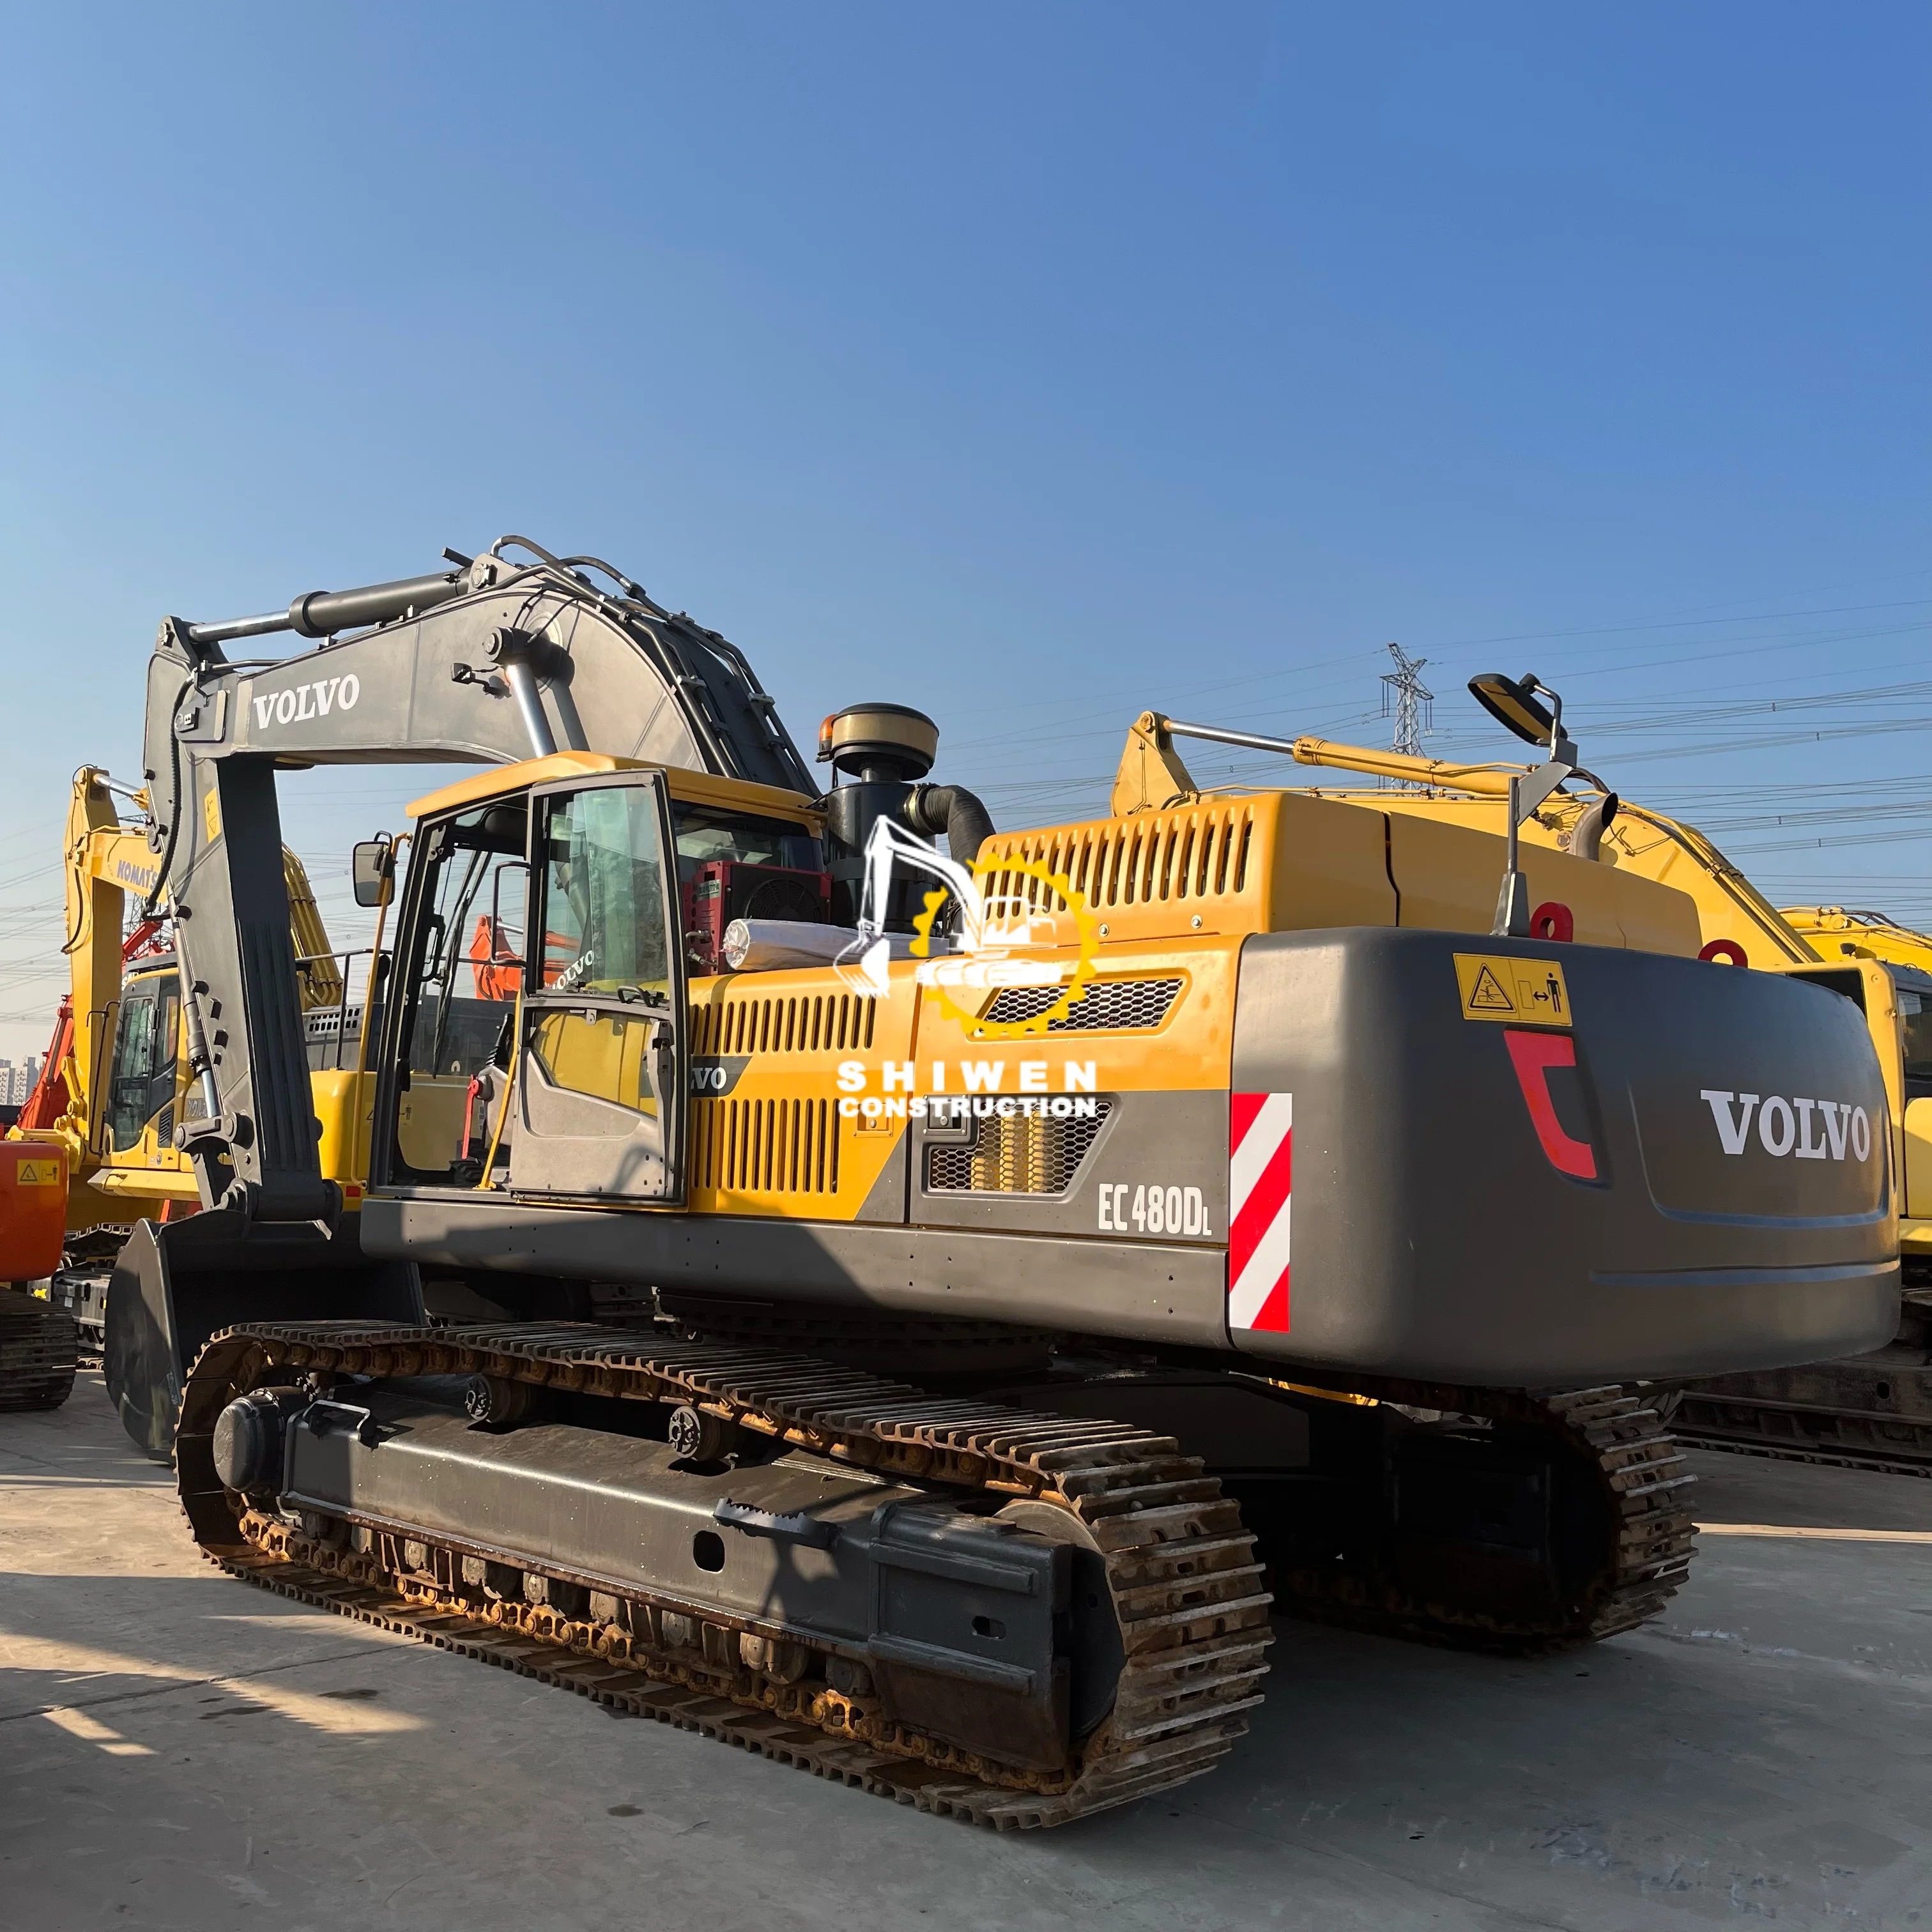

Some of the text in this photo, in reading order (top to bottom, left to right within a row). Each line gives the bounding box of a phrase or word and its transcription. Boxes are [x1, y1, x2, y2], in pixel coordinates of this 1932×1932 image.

[253, 673, 360, 730] VOLVO
[552, 950, 594, 990] OLVO
[1700, 1089, 1870, 1162] VOLVO
